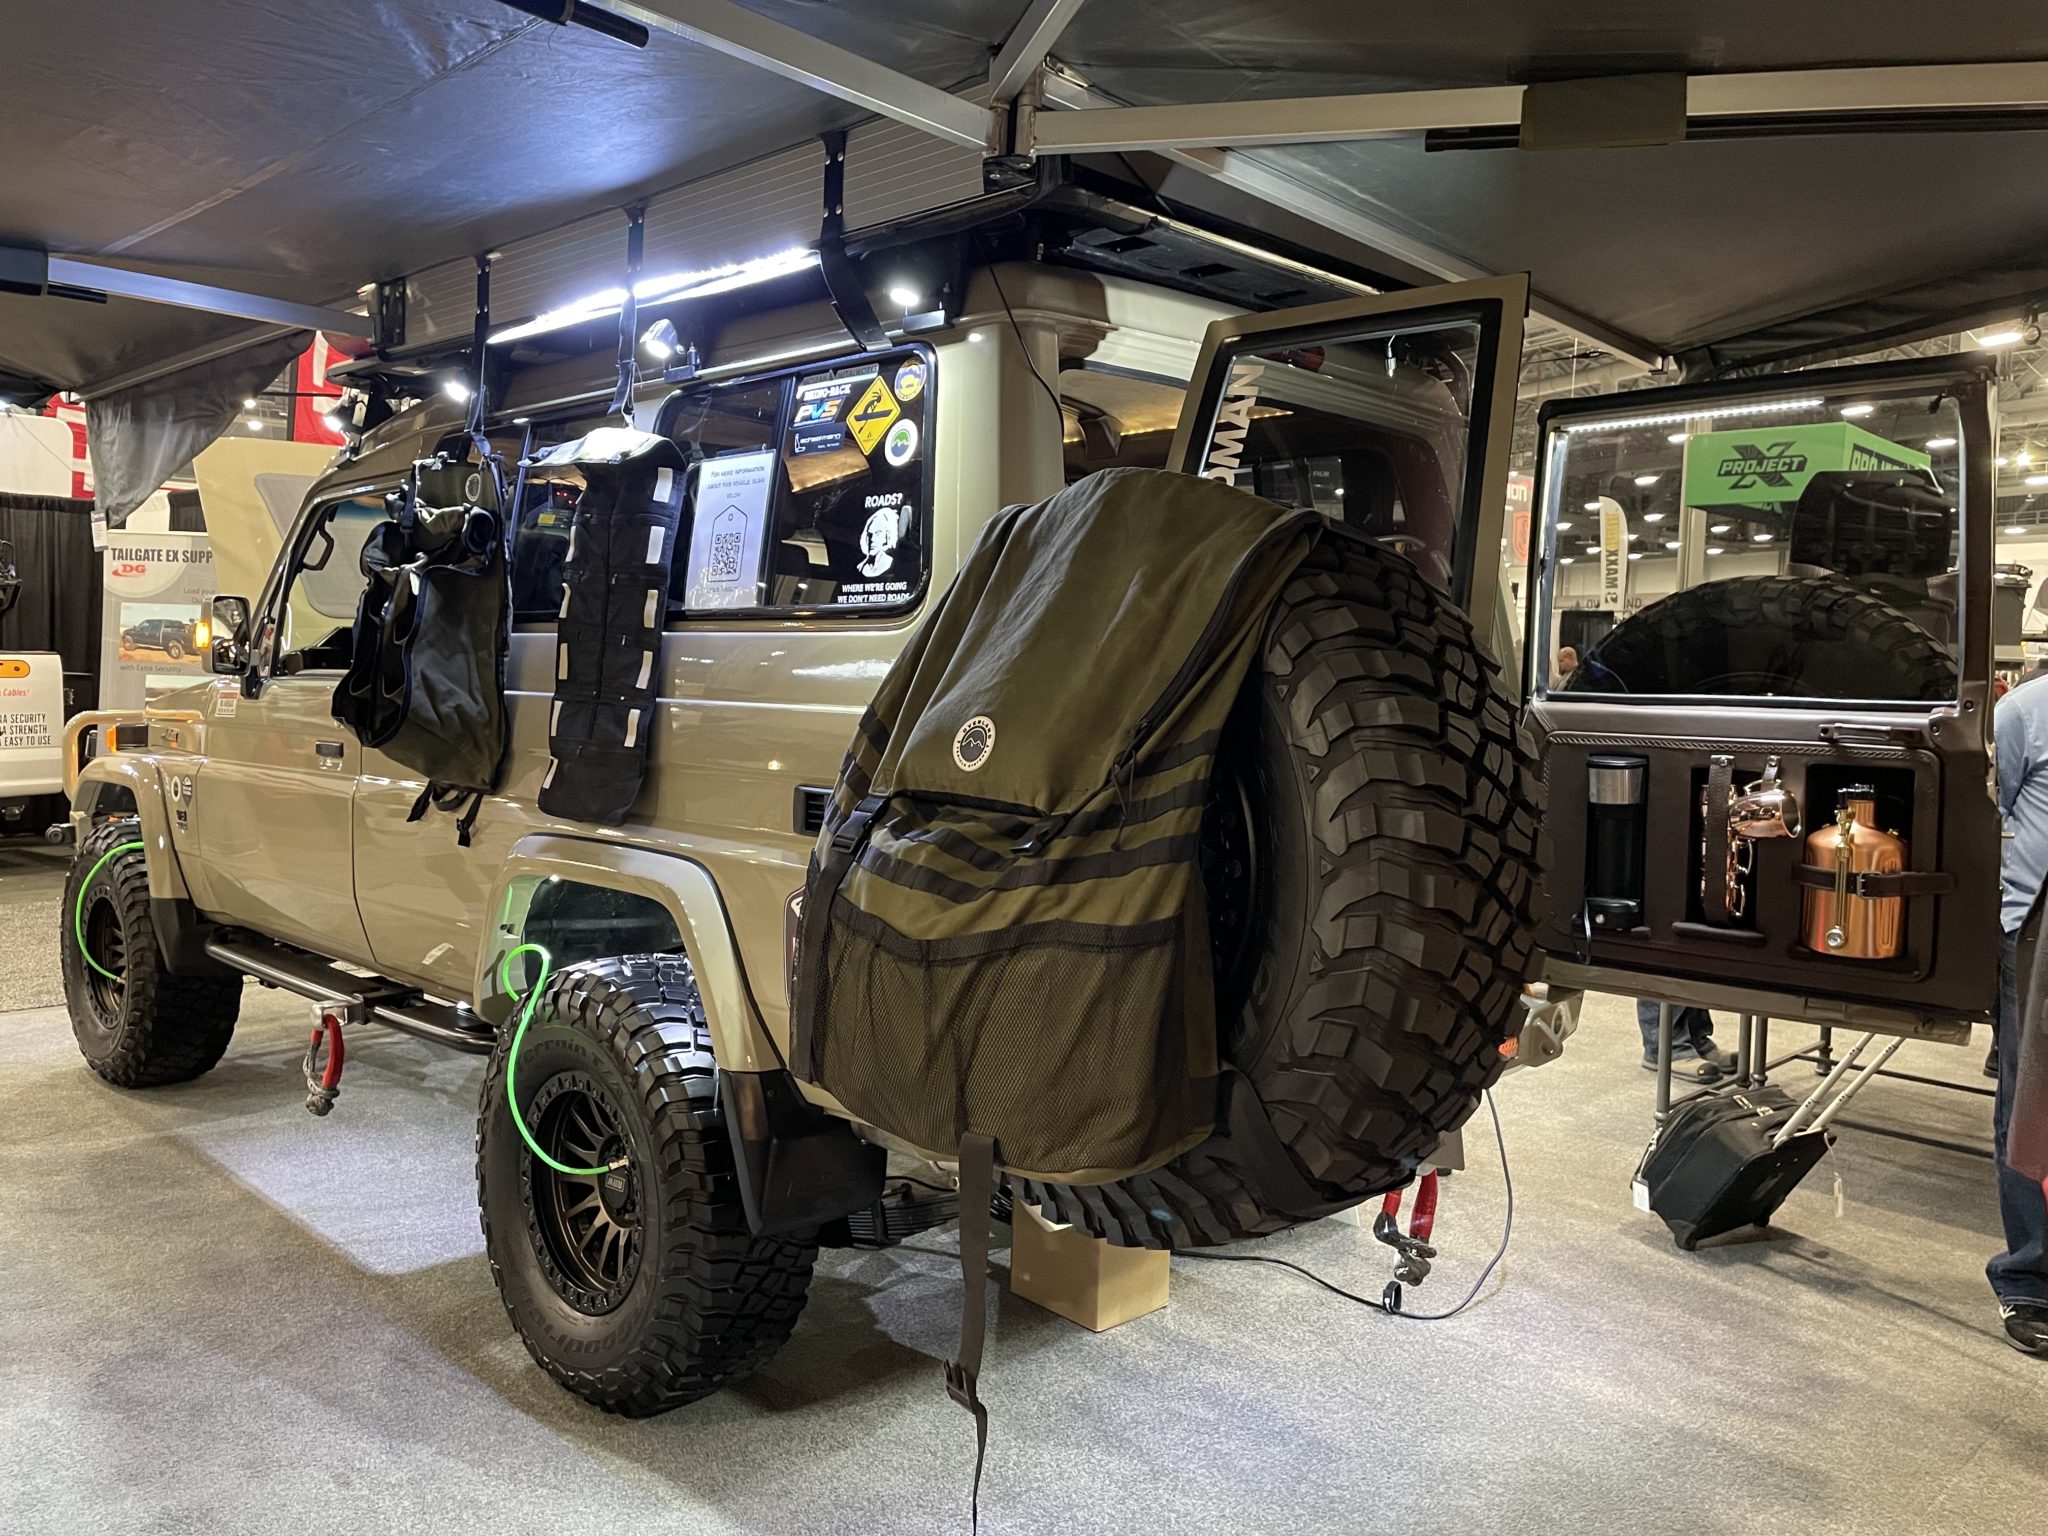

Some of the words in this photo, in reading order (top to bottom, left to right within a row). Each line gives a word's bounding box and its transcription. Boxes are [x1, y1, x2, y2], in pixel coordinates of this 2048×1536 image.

[794, 398, 843, 423] PVS
[1720, 456, 1805, 475] PROJECT
[864, 492, 903, 508] ROADS?
[111, 547, 163, 562] TAILGATE
[165, 548, 180, 563] EX
[121, 564, 147, 574] DG
[842, 583, 863, 593] WHERE
[885, 581, 907, 591] GOING
[837, 595, 847, 604] WE
[848, 594, 868, 604] DON'T
[869, 593, 887, 603] NEED
[120, 664, 135, 672] with
[136, 664, 153, 673] Extra
[155, 664, 182, 674] Security
[10, 713, 46, 724] SECURITY
[9, 724, 47, 735] STRENGTH
[962, 719, 992, 740] OVERLAND
[5, 736, 23, 746] EASY
[27, 735, 35, 745] TO
[37, 735, 51, 745] USE
